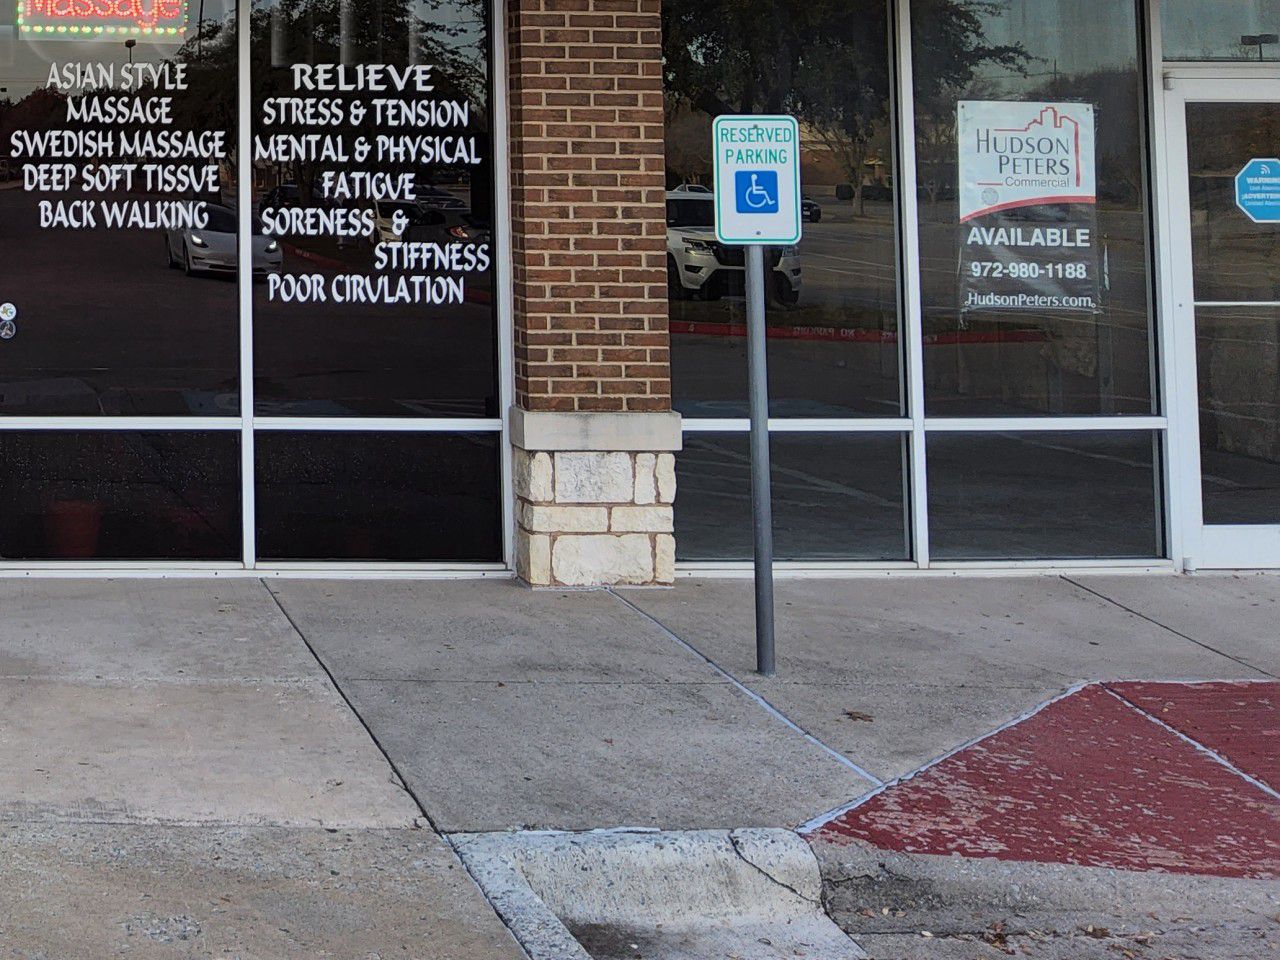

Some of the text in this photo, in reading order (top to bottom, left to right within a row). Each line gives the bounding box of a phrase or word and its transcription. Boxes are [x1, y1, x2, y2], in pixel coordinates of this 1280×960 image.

[45, 61, 189, 90] ASIAN STYLE
[290, 63, 435, 92] RELIEVE
[66, 95, 173, 124] MASSAGE
[262, 97, 469, 128] STRESS & TENSION
[10, 129, 227, 158] SWEDISH MASSAGE
[254, 134, 482, 164] MENTAL & PHYSICAL
[720, 127, 792, 142] RESERVED
[976, 128, 1069, 155] HUDSON
[725, 149, 787, 164] PARKING
[999, 155, 1070, 175] PETERS
[22, 163, 220, 193] DEEP SOFT TISSUE
[322, 171, 417, 201] FATIGUE
[1005, 176, 1070, 188] Commercial
[38, 199, 209, 229] BACK WALKING
[261, 207, 410, 237] SORENESS &
[967, 227, 1091, 247] AVAILABLE
[374, 241, 490, 272] STIFFNESS
[971, 261, 1087, 279] 972-980-1188
[267, 273, 465, 305] POOR CIRULATION
[968, 292, 1092, 307] HudsonPeters.com
